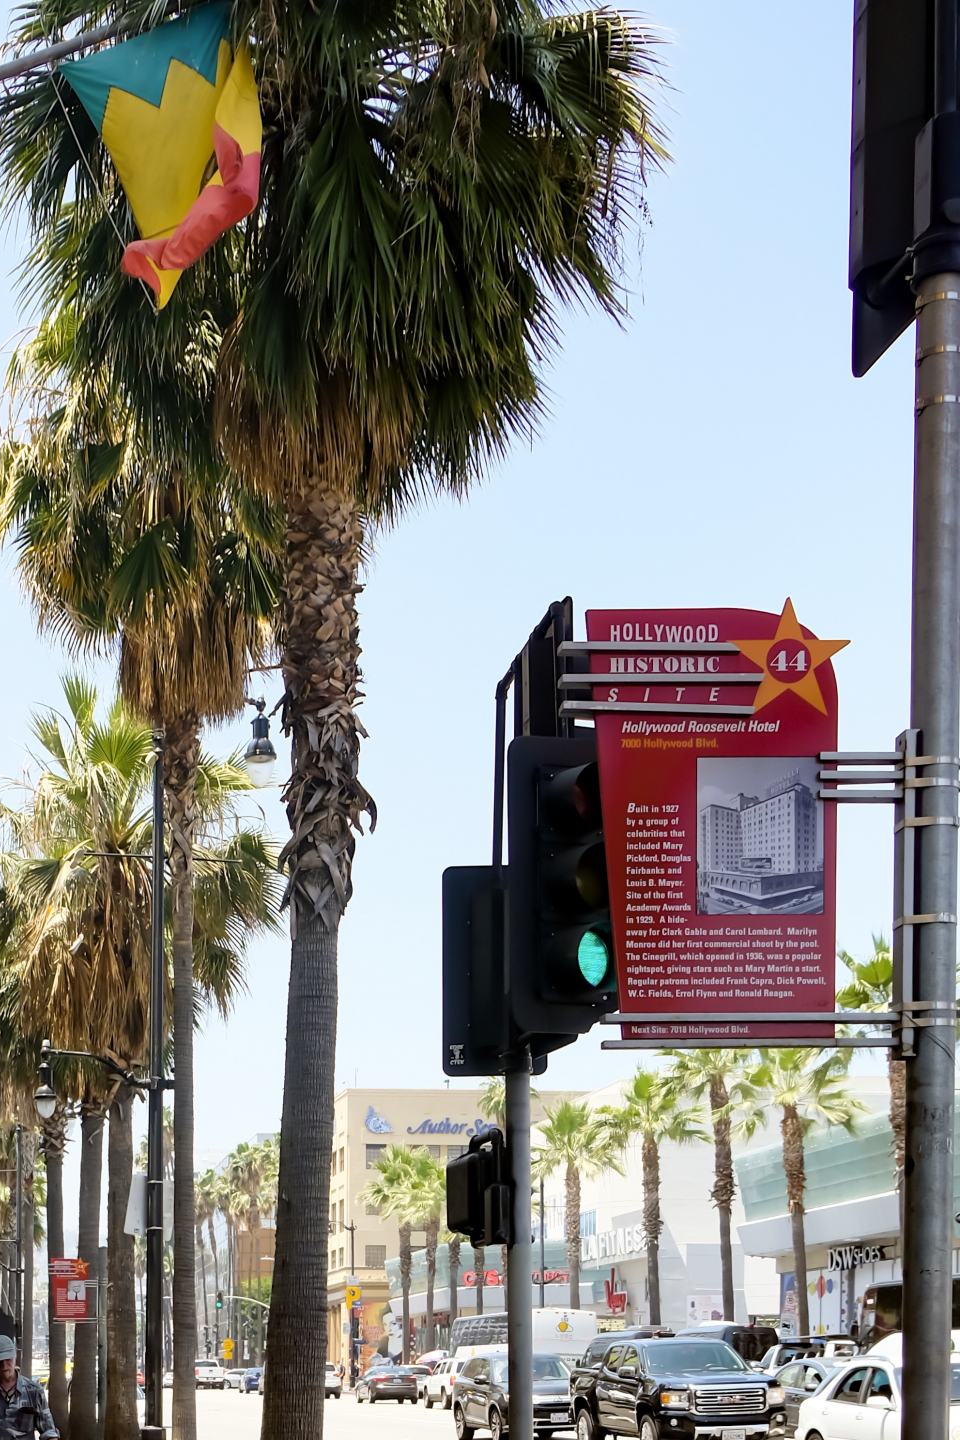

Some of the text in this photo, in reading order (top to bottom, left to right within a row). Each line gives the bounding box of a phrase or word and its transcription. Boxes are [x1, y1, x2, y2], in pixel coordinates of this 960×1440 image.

[610, 623, 719, 643] HOLLYWOOD
[609, 656, 720, 673] HISTORIC
[770, 650, 807, 672] 44
[622, 720, 780, 735] Hollywood Roosevelt Hotel
[621, 738, 719, 750] 7000 Hollywood Blvd.
[627, 803, 679, 813] Built in 1927
[626, 818, 635, 827] by
[646, 819, 668, 827] group
[671, 817, 679, 825] of
[626, 830, 668, 838] celebrities
[626, 842, 683, 851] included Mary
[626, 854, 691, 863] Pickford, Douglas
[626, 867, 682, 875] Fairbanks and
[626, 879, 685, 888] Louis B. Mayer.
[626, 891, 683, 899] Site of the first
[626, 903, 691, 912] Academy Awards
[626, 916, 634, 924] in
[636, 916, 655, 924] 1929.
[667, 916, 688, 924] hide-
[626, 927, 817, 937] away for Clark Gable and Carol Lombard. Marilyn
[626, 940, 819, 949] Monroe did her first commercial shoot by the pool.
[642, 953, 678, 962] Cinegrill,
[706, 953, 734, 962] opened
[736, 952, 744, 960] in
[792, 952, 822, 962] popular
[627, 965, 665, 974] nightspot,
[667, 965, 691, 974] giving
[713, 965, 732, 973] such
[745, 965, 765, 974] Mary
[627, 977, 826, 987] Regular patrons included Frank Capra, Dick Powell,
[648, 990, 674, 998] Fields,
[675, 990, 694, 998] Errol
[696, 990, 717, 999] Flynn
[719, 989, 733, 997] and
[735, 989, 762, 997] Ronald
[764, 989, 795, 999] Reagan.
[631, 1026, 751, 1036] Next Site: 7018 Hollywood Blvd.
[407, 1117, 469, 1135] Author
[581, 1234, 598, 1262] LA
[828, 1245, 880, 1272] DSW SHOES
